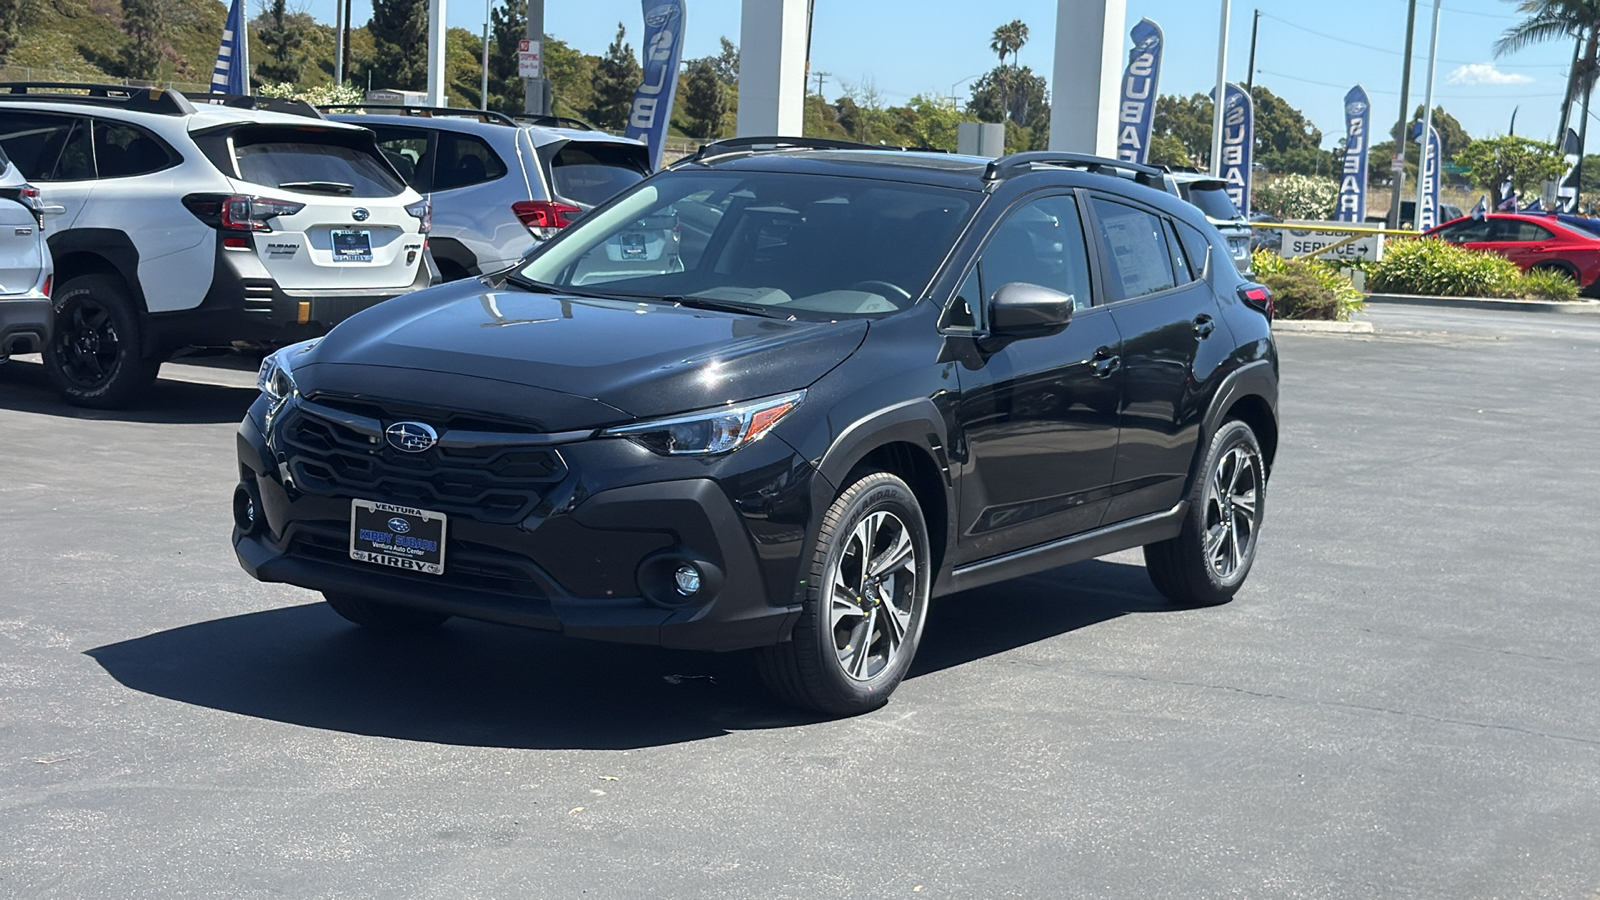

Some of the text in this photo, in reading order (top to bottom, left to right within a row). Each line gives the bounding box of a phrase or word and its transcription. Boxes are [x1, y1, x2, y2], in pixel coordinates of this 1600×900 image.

[375, 503, 422, 516] VENTURA
[360, 528, 438, 552] KIRBY SUBARU
[372, 541, 425, 556] Ventura Auto Center
[367, 553, 426, 571] KIRBY
